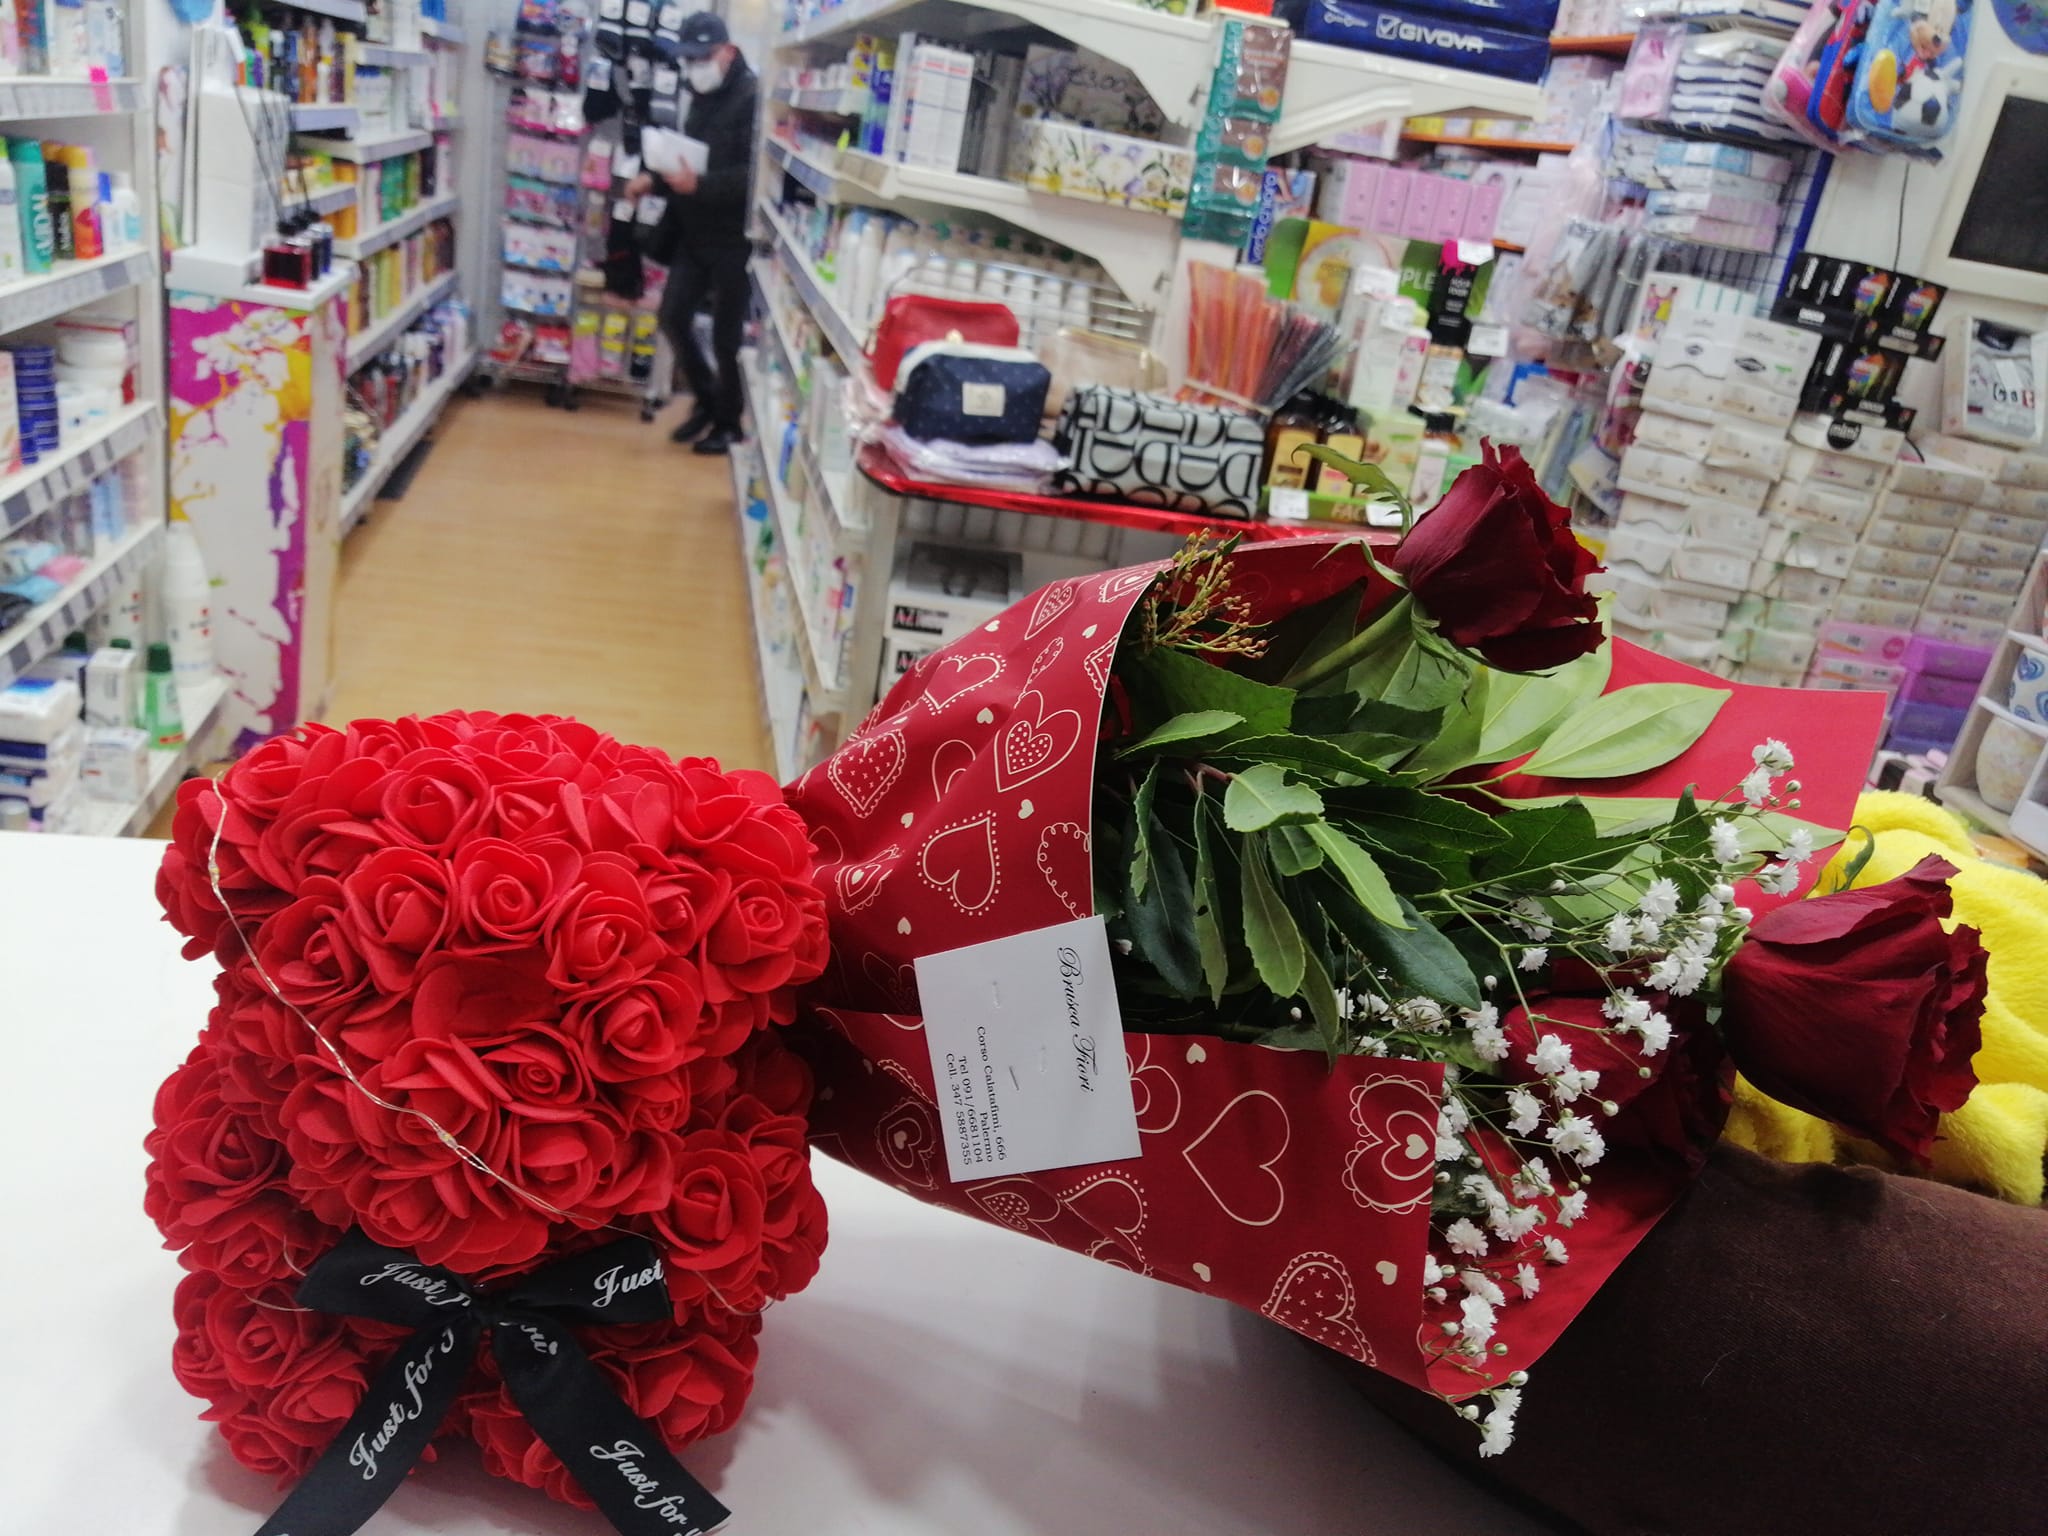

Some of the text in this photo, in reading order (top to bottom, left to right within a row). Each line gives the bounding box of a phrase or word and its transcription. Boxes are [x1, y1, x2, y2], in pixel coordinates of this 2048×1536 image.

[1399, 23, 1484, 54] GIVOVA
[1401, 266, 1438, 292] PLE
[1057, 947, 1098, 1093] Brusca Fiori
[946, 1053, 973, 1166] Cell. 347 5887355
[958, 1055, 984, 1163] Tel 091/6681104
[977, 1026, 989, 1062] Corso
[984, 1065, 1002, 1133] Calatafimi,
[979, 1112, 993, 1162] Palermo
[360, 1262, 448, 1294] Just
[592, 1258, 665, 1308] Just
[349, 1346, 436, 1481] Just for
[589, 1439, 660, 1493] Just
[633, 1495, 688, 1525] for
